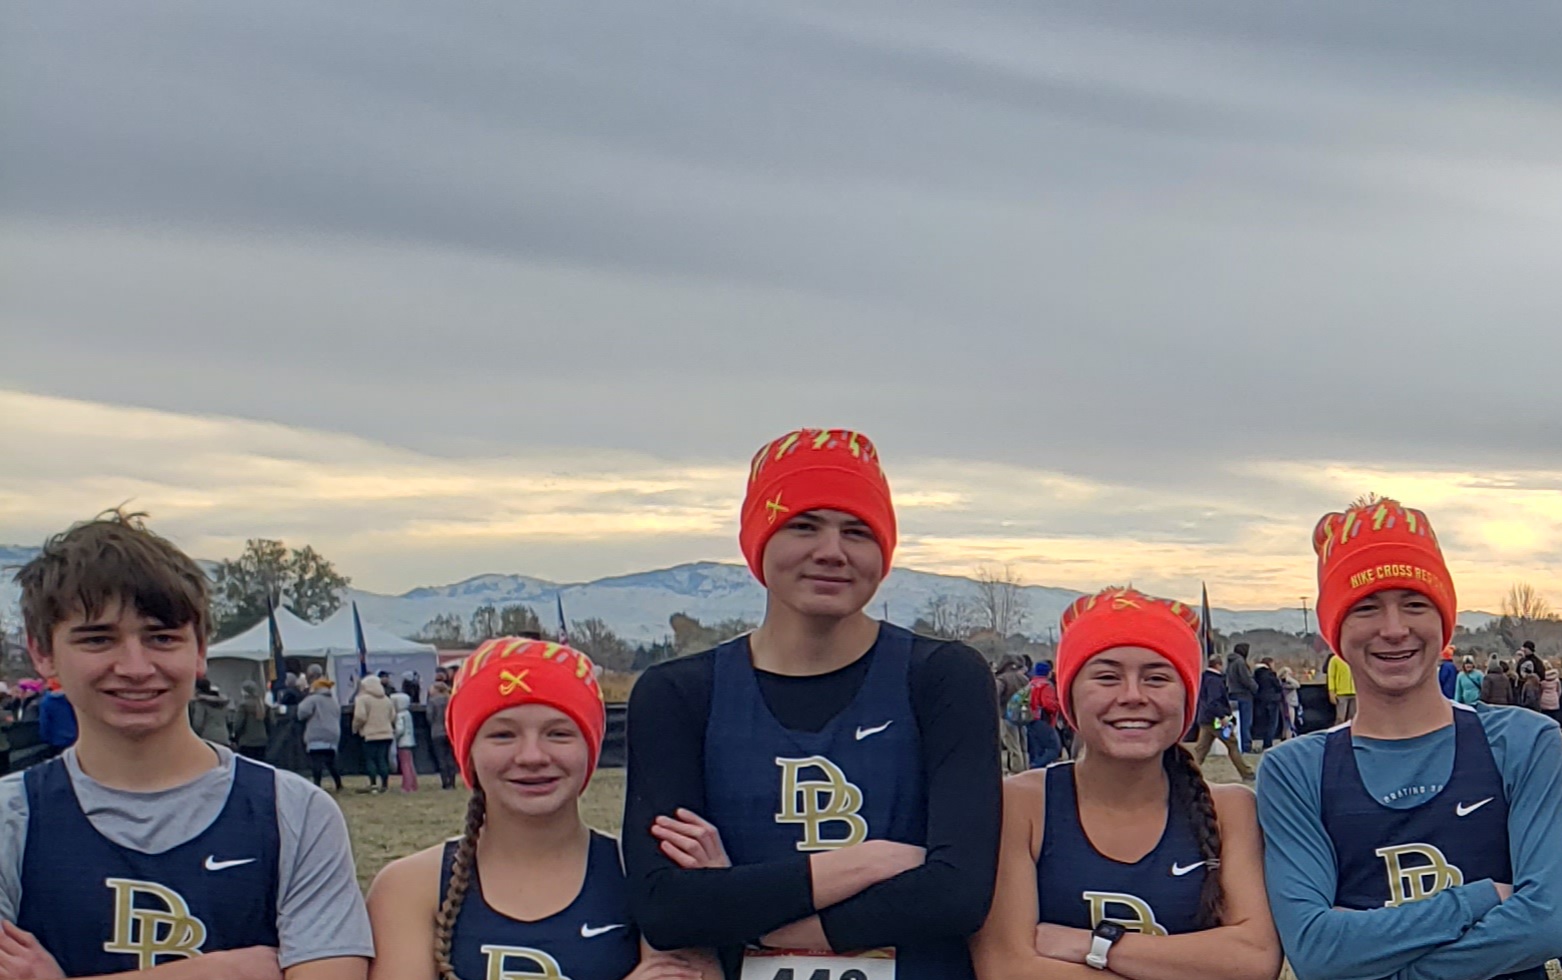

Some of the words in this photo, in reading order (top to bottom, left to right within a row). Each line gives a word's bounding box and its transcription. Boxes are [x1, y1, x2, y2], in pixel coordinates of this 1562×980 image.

[1351, 569, 1376, 588] NIKE
[1376, 565, 1413, 579] CROSS
[775, 755, 868, 851] DB
